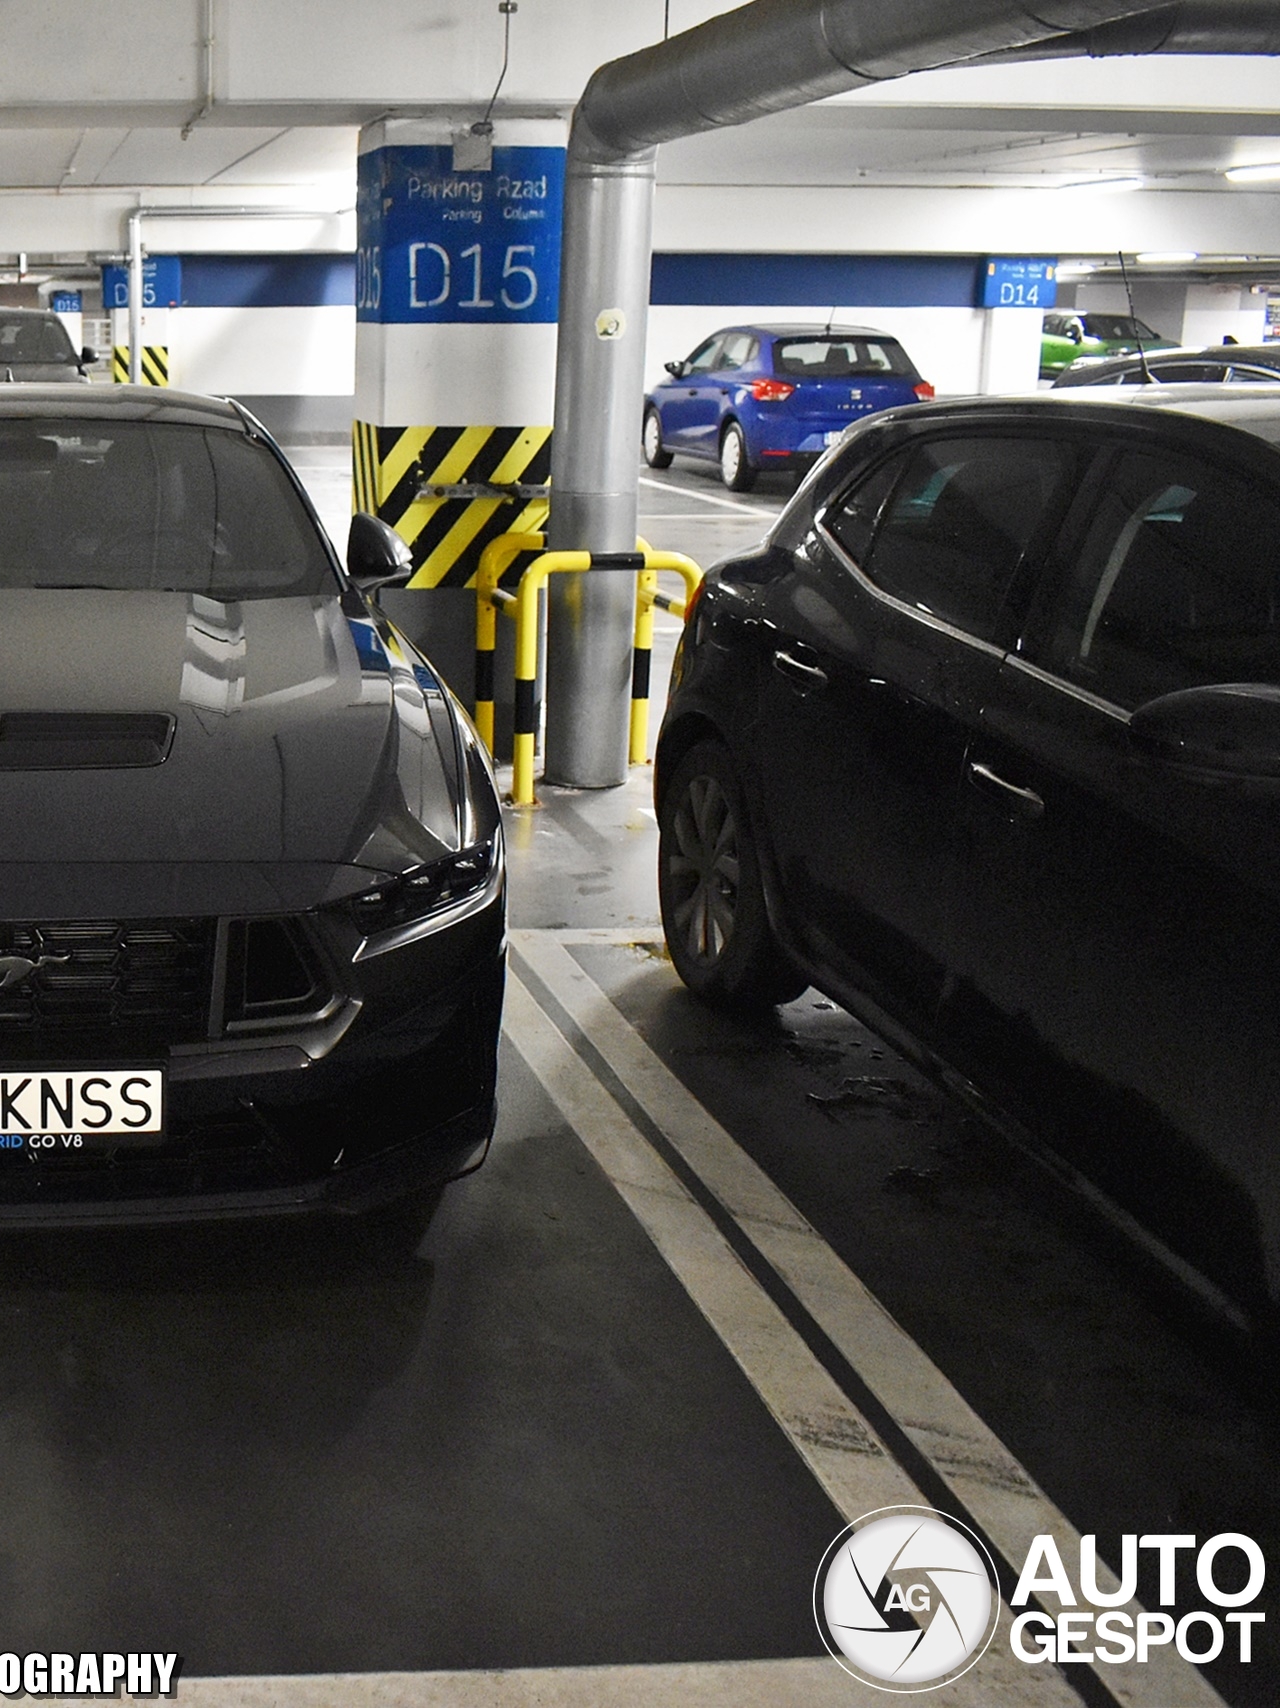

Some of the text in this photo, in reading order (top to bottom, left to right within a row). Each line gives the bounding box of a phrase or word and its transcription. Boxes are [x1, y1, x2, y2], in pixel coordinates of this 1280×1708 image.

[408, 177, 483, 203] Parking
[407, 242, 538, 310] D15
[115, 283, 156, 305] D5
[1000, 282, 1039, 305] D14
[28, 1135, 56, 1148] GO
[60, 1134, 84, 1147] V8
